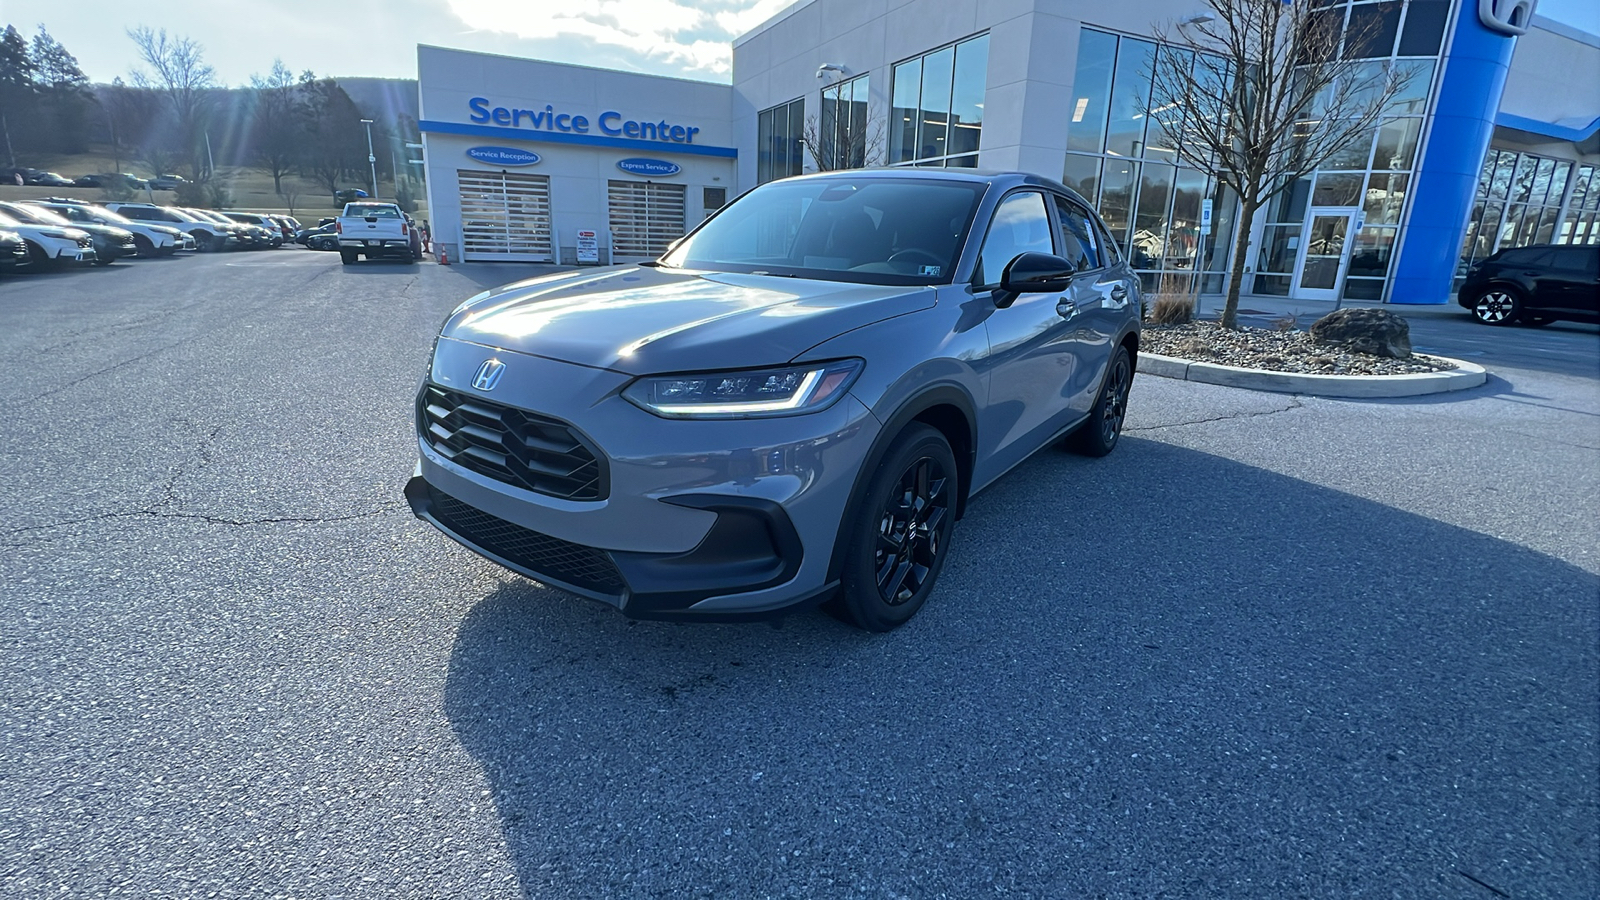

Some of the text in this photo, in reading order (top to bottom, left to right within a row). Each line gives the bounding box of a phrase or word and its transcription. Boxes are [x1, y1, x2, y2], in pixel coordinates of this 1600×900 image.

[469, 97, 700, 143] Service Center
[470, 149, 536, 161] Service Reception
[621, 162, 668, 171] Express Service
